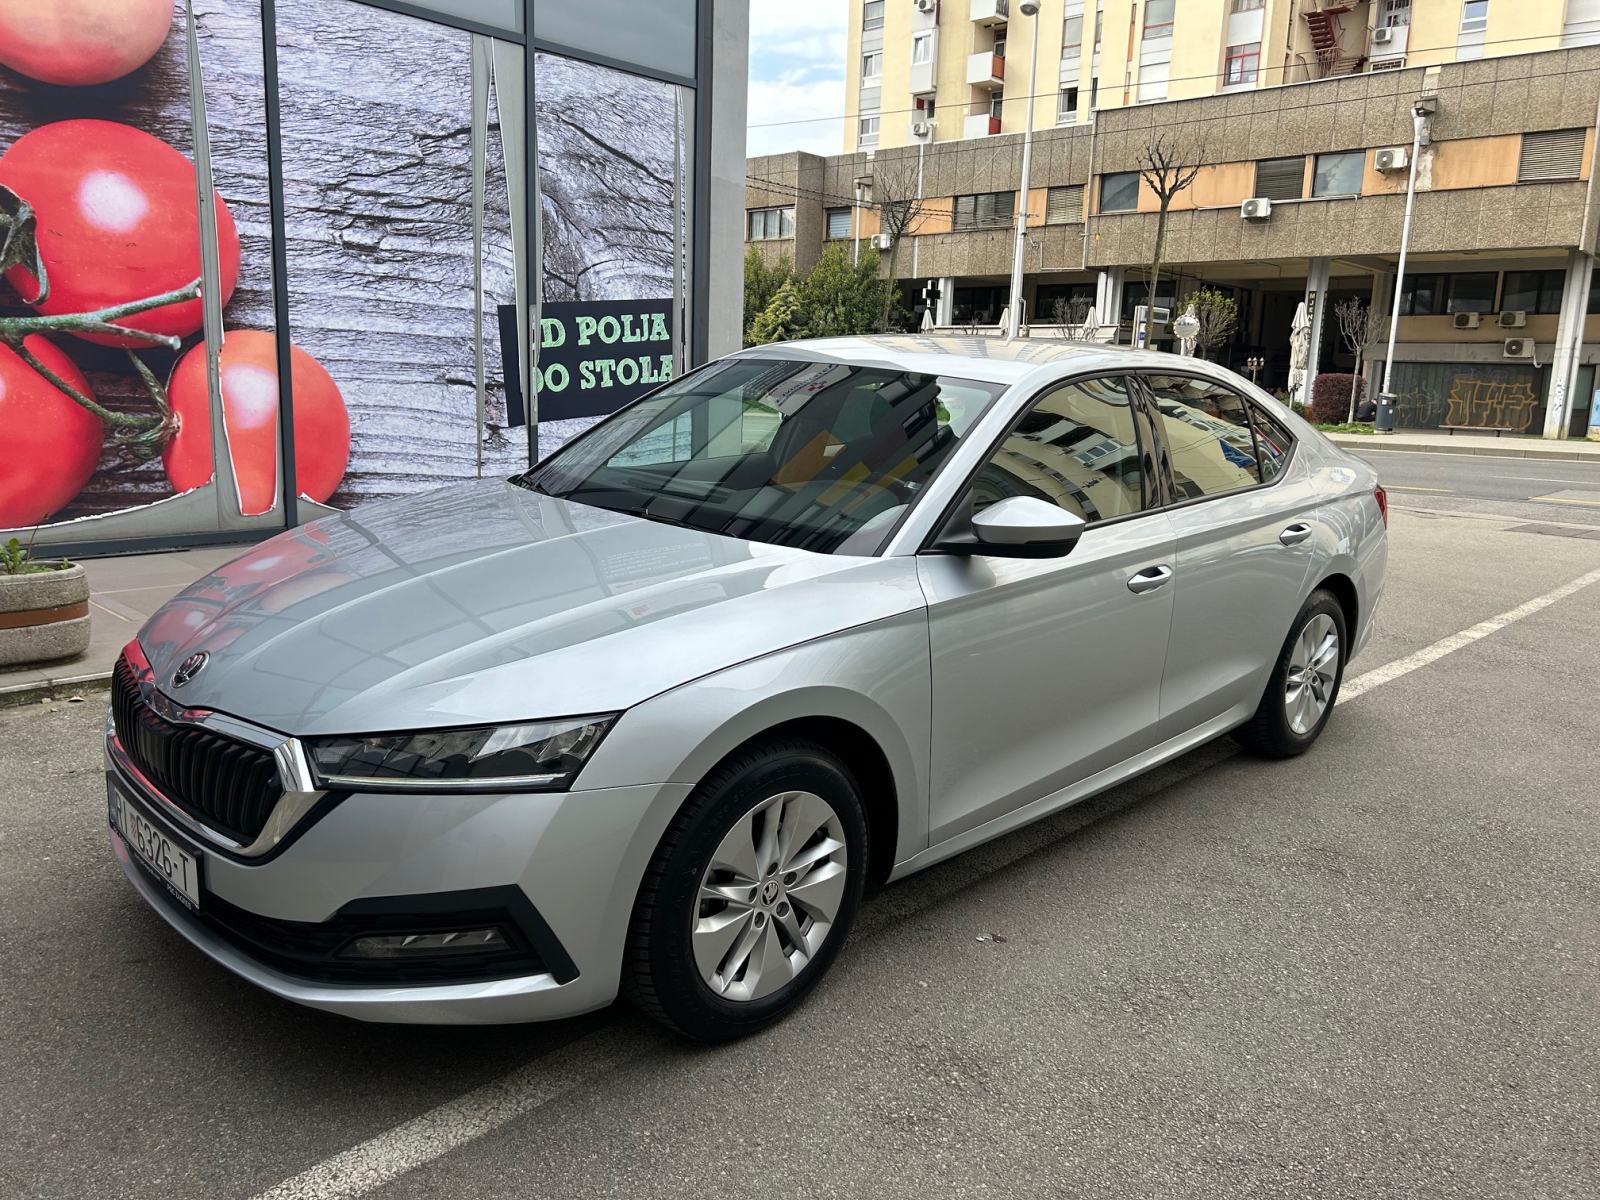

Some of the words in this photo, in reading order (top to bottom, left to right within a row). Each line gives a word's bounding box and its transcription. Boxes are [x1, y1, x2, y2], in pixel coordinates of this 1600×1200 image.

[540, 318, 566, 348] D
[575, 313, 670, 346] POLJA
[579, 354, 673, 390] STOLA
